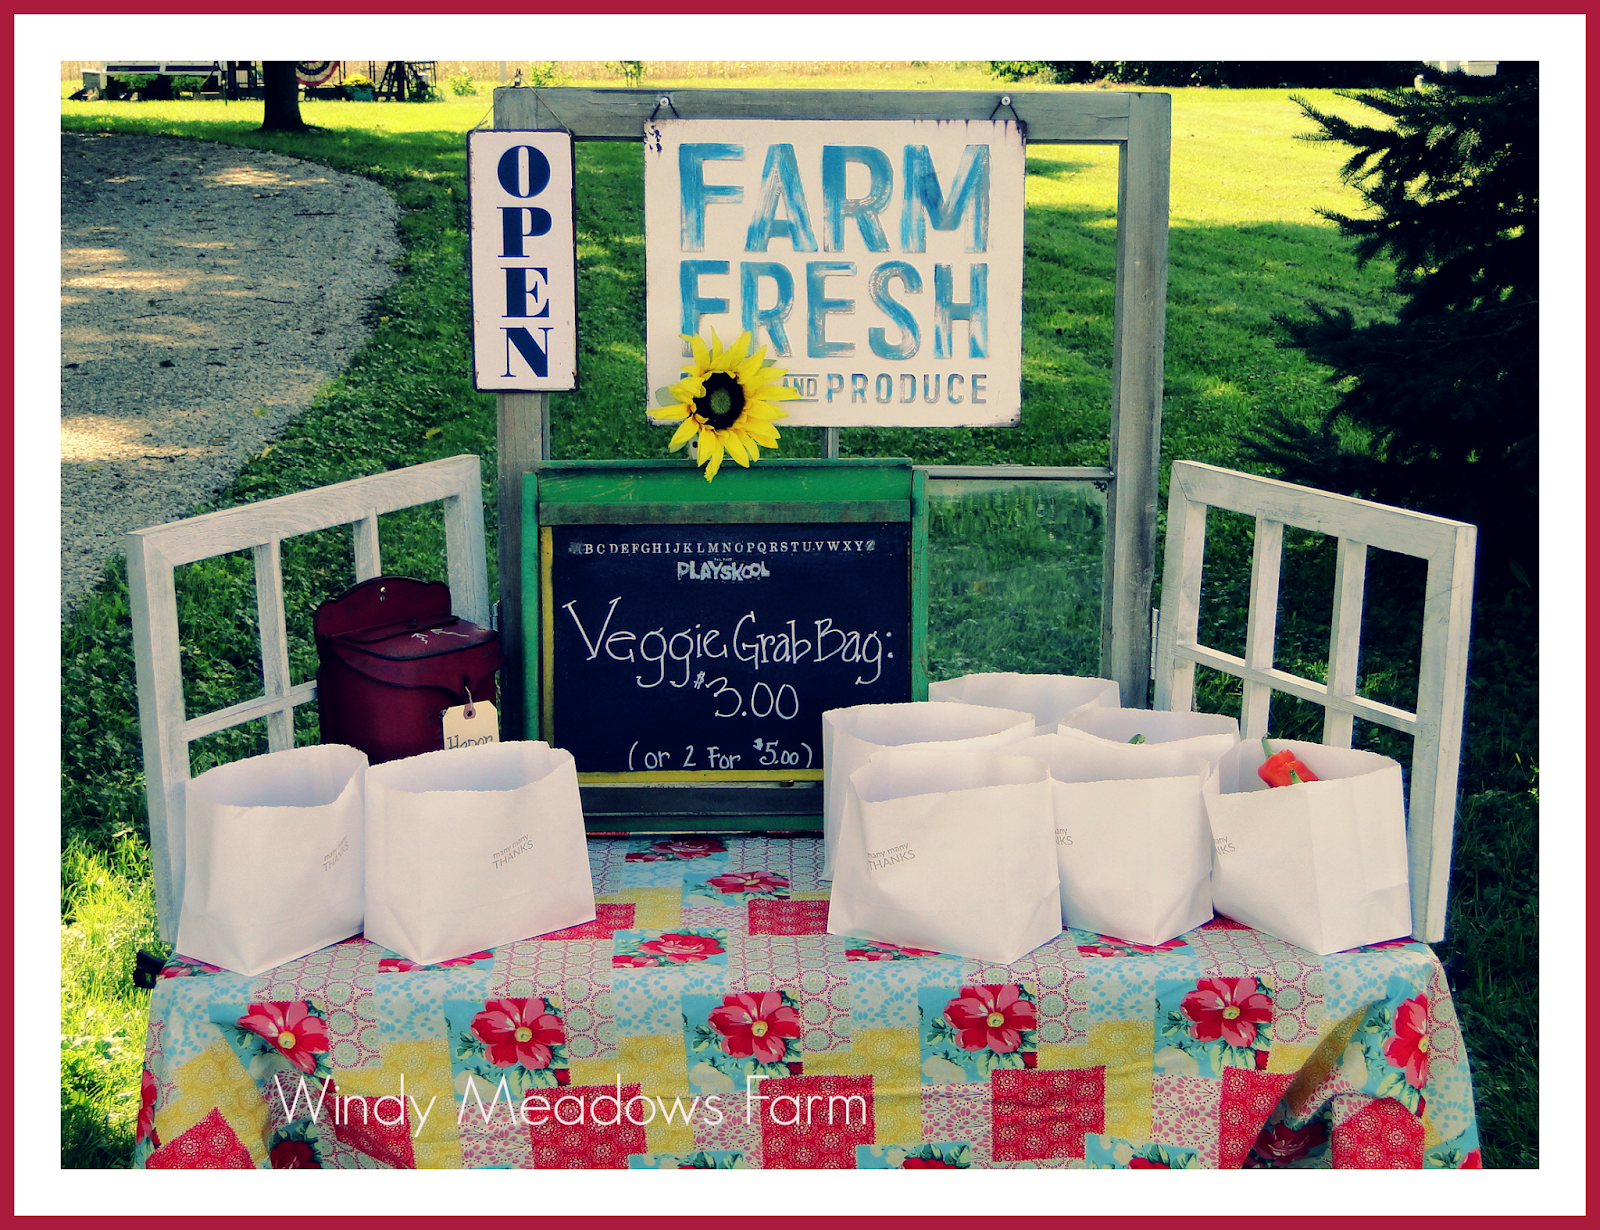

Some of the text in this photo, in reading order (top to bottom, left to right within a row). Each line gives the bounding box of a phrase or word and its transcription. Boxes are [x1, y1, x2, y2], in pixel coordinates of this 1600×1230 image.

[678, 143, 991, 254] FARM
[497, 145, 554, 378] OPEN
[679, 260, 989, 361] FRESH
[826, 372, 988, 404] PRODUCE
[677, 560, 770, 581] PLAYSKOOL
[562, 596, 895, 688] Veggie Grab Bag:
[693, 670, 799, 720] $3.00
[682, 745, 697, 767] 2
[706, 746, 742, 769] For
[492, 833, 530, 859] many many
[1055, 828, 1068, 836] any
[1215, 836, 1228, 844] any
[492, 839, 534, 869] THANKS
[867, 849, 916, 871] THANKS
[887, 842, 909, 855] many
